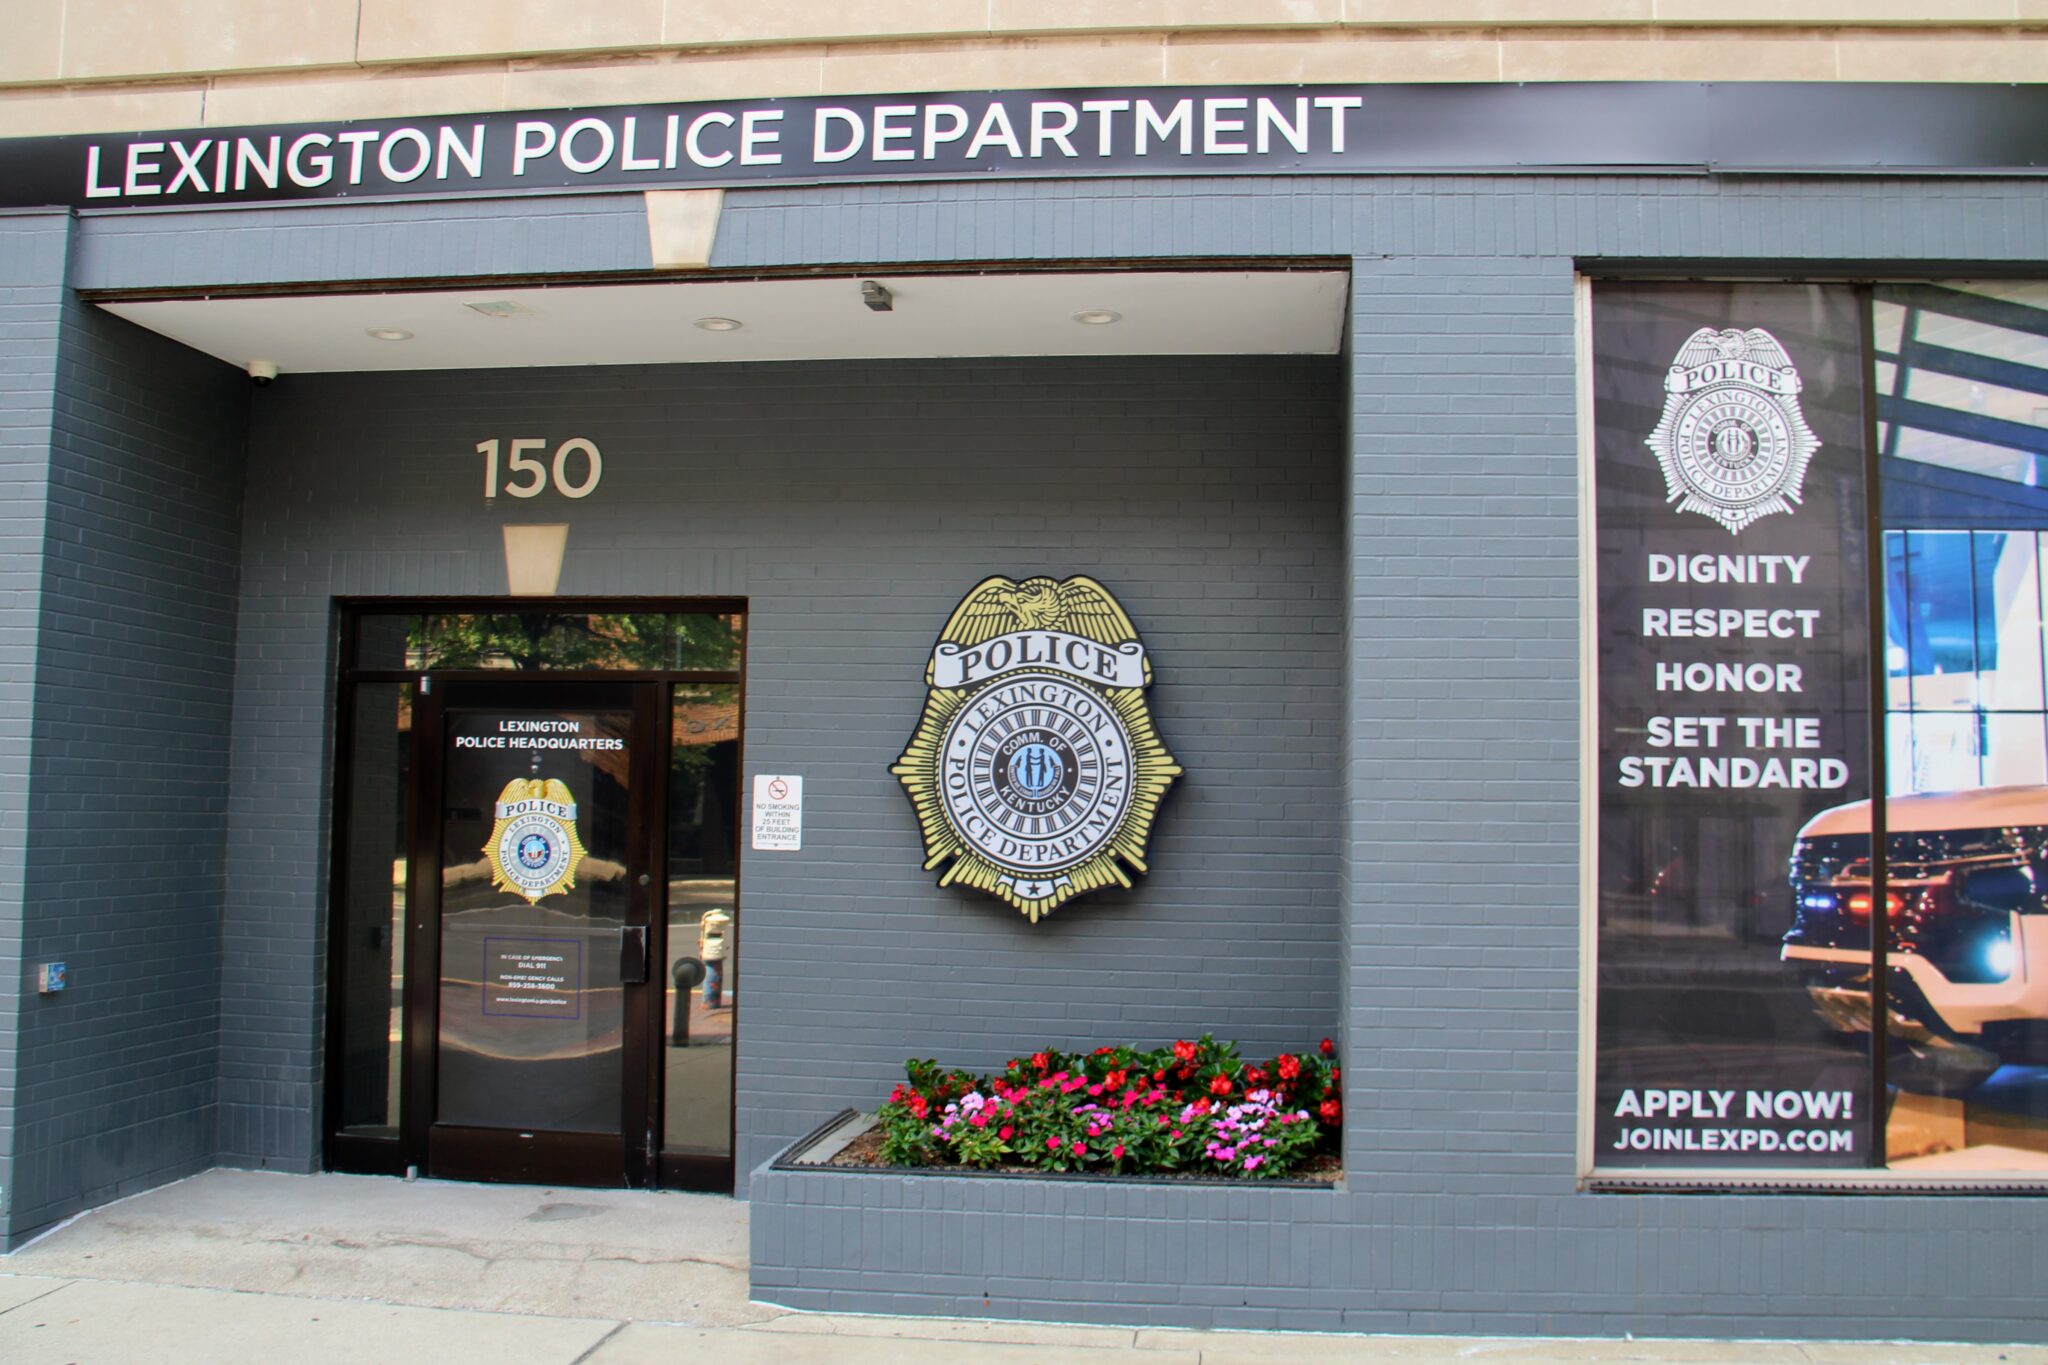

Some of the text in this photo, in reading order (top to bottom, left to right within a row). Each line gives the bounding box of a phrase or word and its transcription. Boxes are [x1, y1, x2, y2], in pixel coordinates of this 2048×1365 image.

[85, 95, 1364, 198] LEXINGTON POLICE DEPARTMENT
[1685, 362, 1782, 391] POLICE
[1689, 390, 1777, 422] LEXINGTON
[476, 437, 602, 498] 150
[1680, 435, 1787, 498] POLICE DEPARTMENT
[1648, 554, 1810, 584] DIGNITY
[1642, 608, 1820, 638] RESPECT
[957, 635, 1119, 683] POLICE
[1656, 662, 1803, 692] HONOR
[964, 684, 1109, 736] LEXINGTON
[499, 720, 579, 733] LEXINGTON
[1646, 716, 1821, 748] SET THE
[456, 736, 624, 750] POLICE HEADQUARTERS
[1002, 731, 1068, 756] COMM. OF
[1618, 756, 1849, 789] STANDARD
[505, 801, 567, 818] POLICE
[768, 803, 800, 811] SMOKING
[949, 757, 1124, 862] POLICE DEPARTMENT
[1000, 785, 1070, 813] KENTUCKY
[508, 816, 562, 833] LEXINGTON
[757, 833, 798, 841] ENTRANCE
[501, 850, 568, 887] POLICE DEPARTMENT
[1613, 1089, 1854, 1120] APPLY NOW!
[1613, 1127, 1854, 1153] JOINLEXPD.COM
